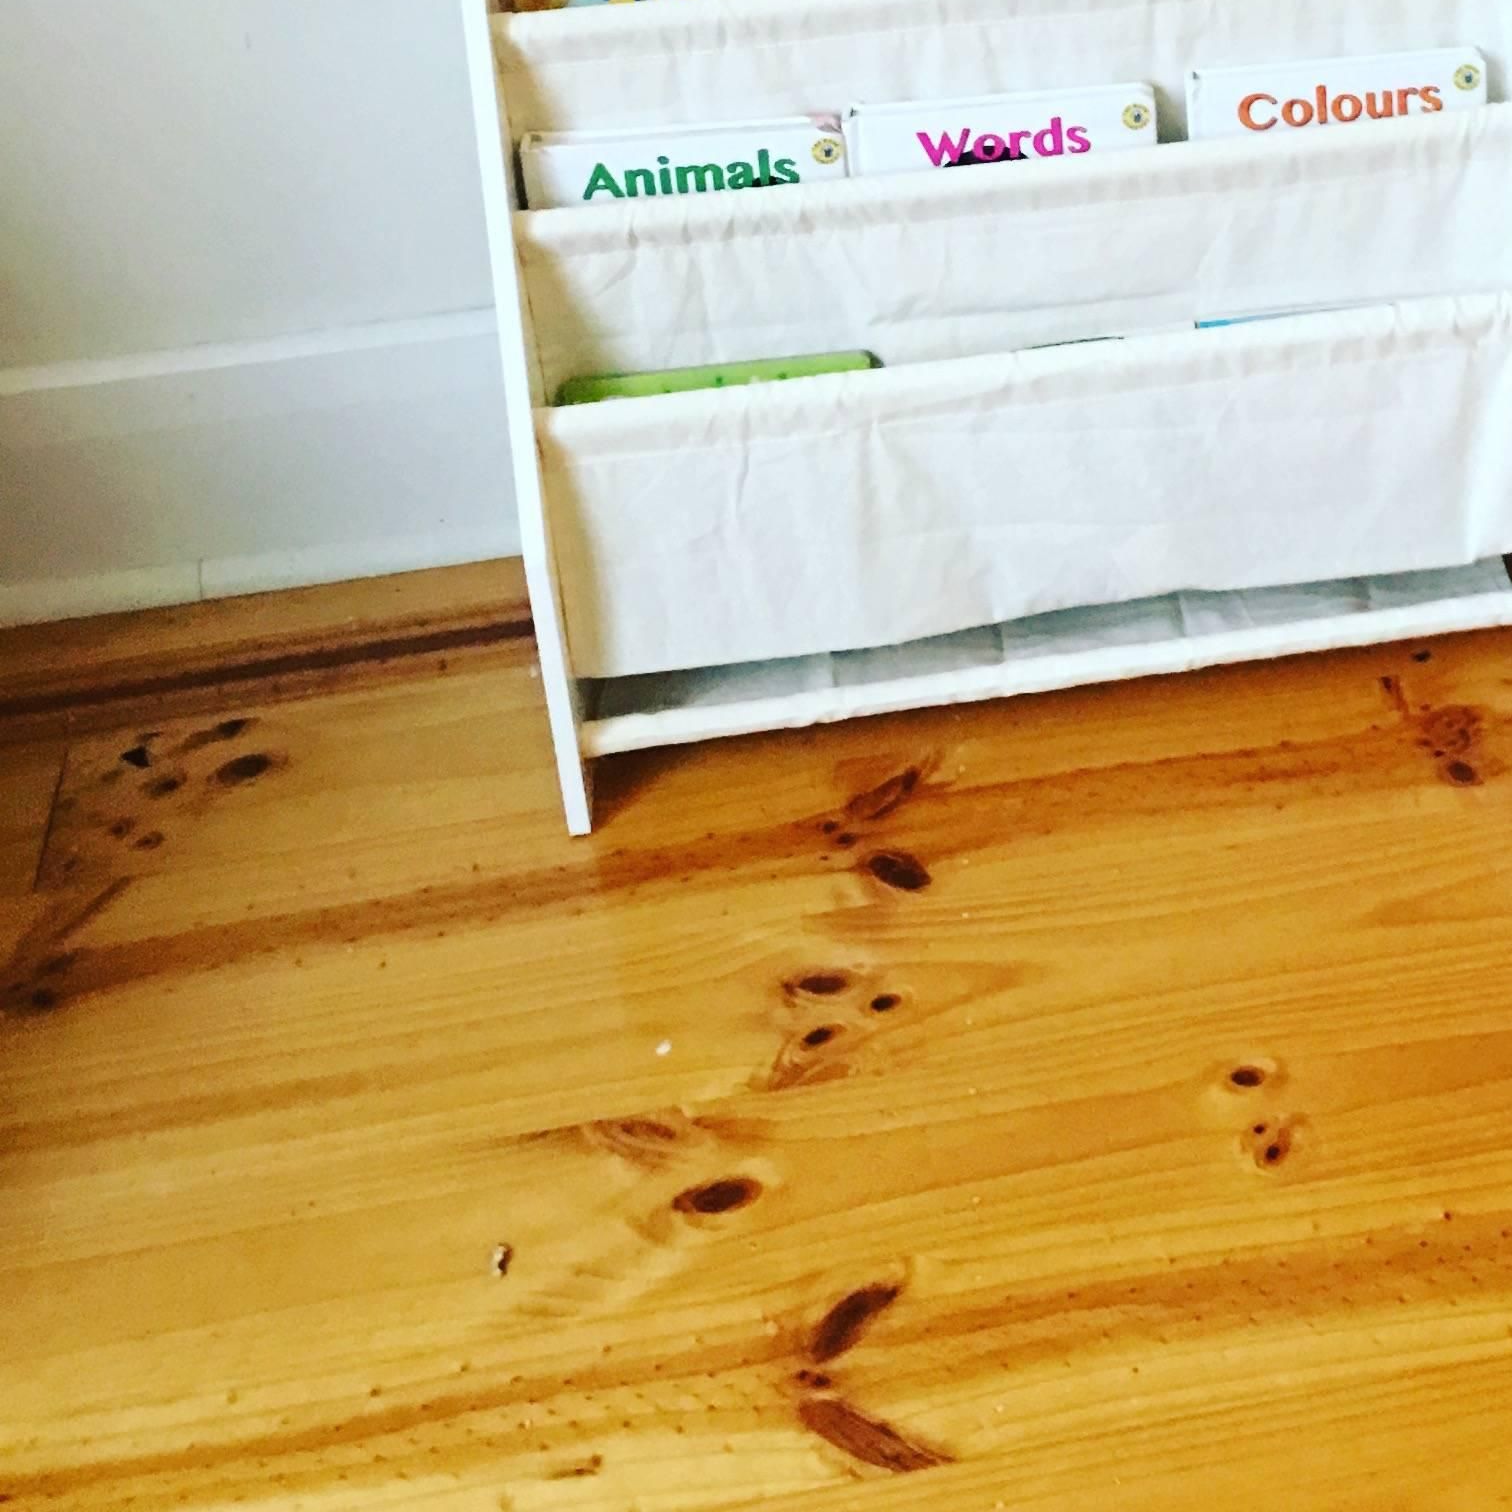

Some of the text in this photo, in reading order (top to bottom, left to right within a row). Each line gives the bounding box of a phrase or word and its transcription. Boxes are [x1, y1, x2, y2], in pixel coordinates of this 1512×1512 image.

[1237, 84, 1443, 131] Colours
[916, 116, 1092, 167] Words
[583, 148, 800, 200] Animals
